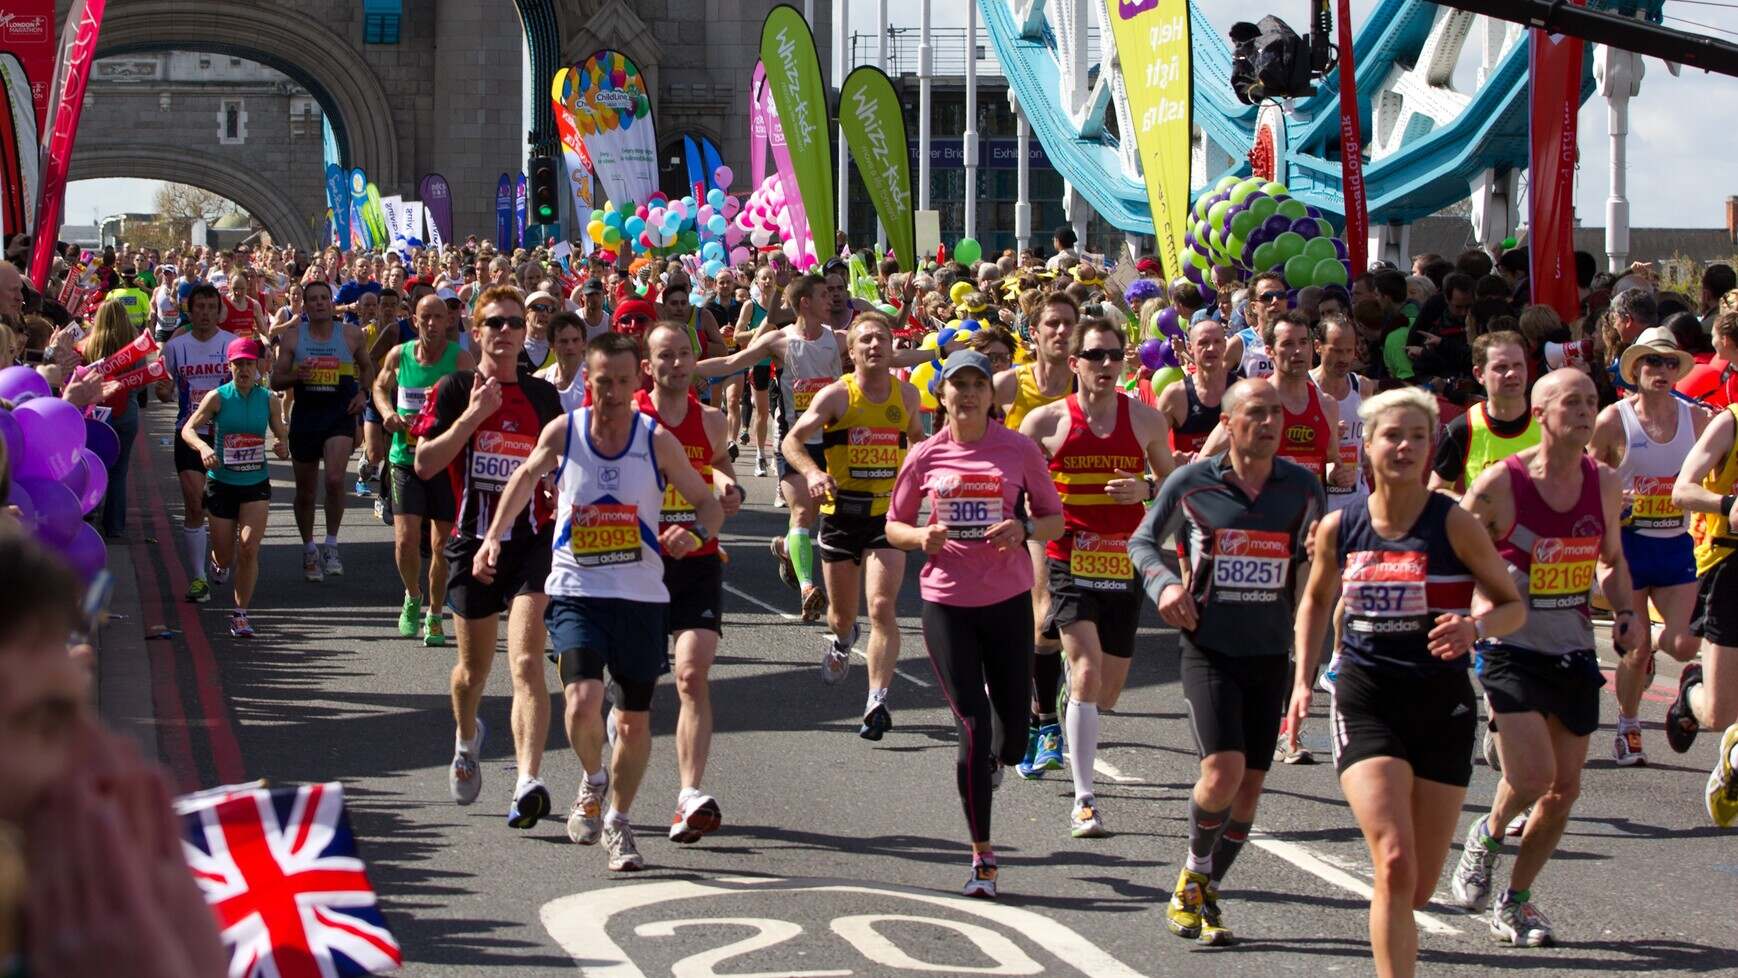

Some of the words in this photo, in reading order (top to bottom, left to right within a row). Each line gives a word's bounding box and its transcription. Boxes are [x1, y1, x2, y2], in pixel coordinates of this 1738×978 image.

[180, 363, 229, 376] FRANCE
[872, 432, 898, 440] money
[504, 440, 533, 450] money
[233, 448, 256, 460] 477
[850, 448, 897, 464] 32344
[964, 481, 1000, 492] money
[601, 510, 635, 522] money
[950, 501, 988, 521] 306
[665, 513, 696, 522] adidas
[574, 528, 639, 549] 32993
[600, 551, 635, 563] adidas
[1073, 554, 1130, 576] 33393
[1376, 562, 1424, 575] money
[1217, 560, 1283, 583] 58251
[1532, 565, 1592, 590] 32169
[1094, 580, 1127, 589] adidas
[1242, 590, 1278, 602] adidas
[1360, 585, 1406, 611] 537
[1374, 620, 1420, 632] adidas
[635, 914, 1045, 978] 20
